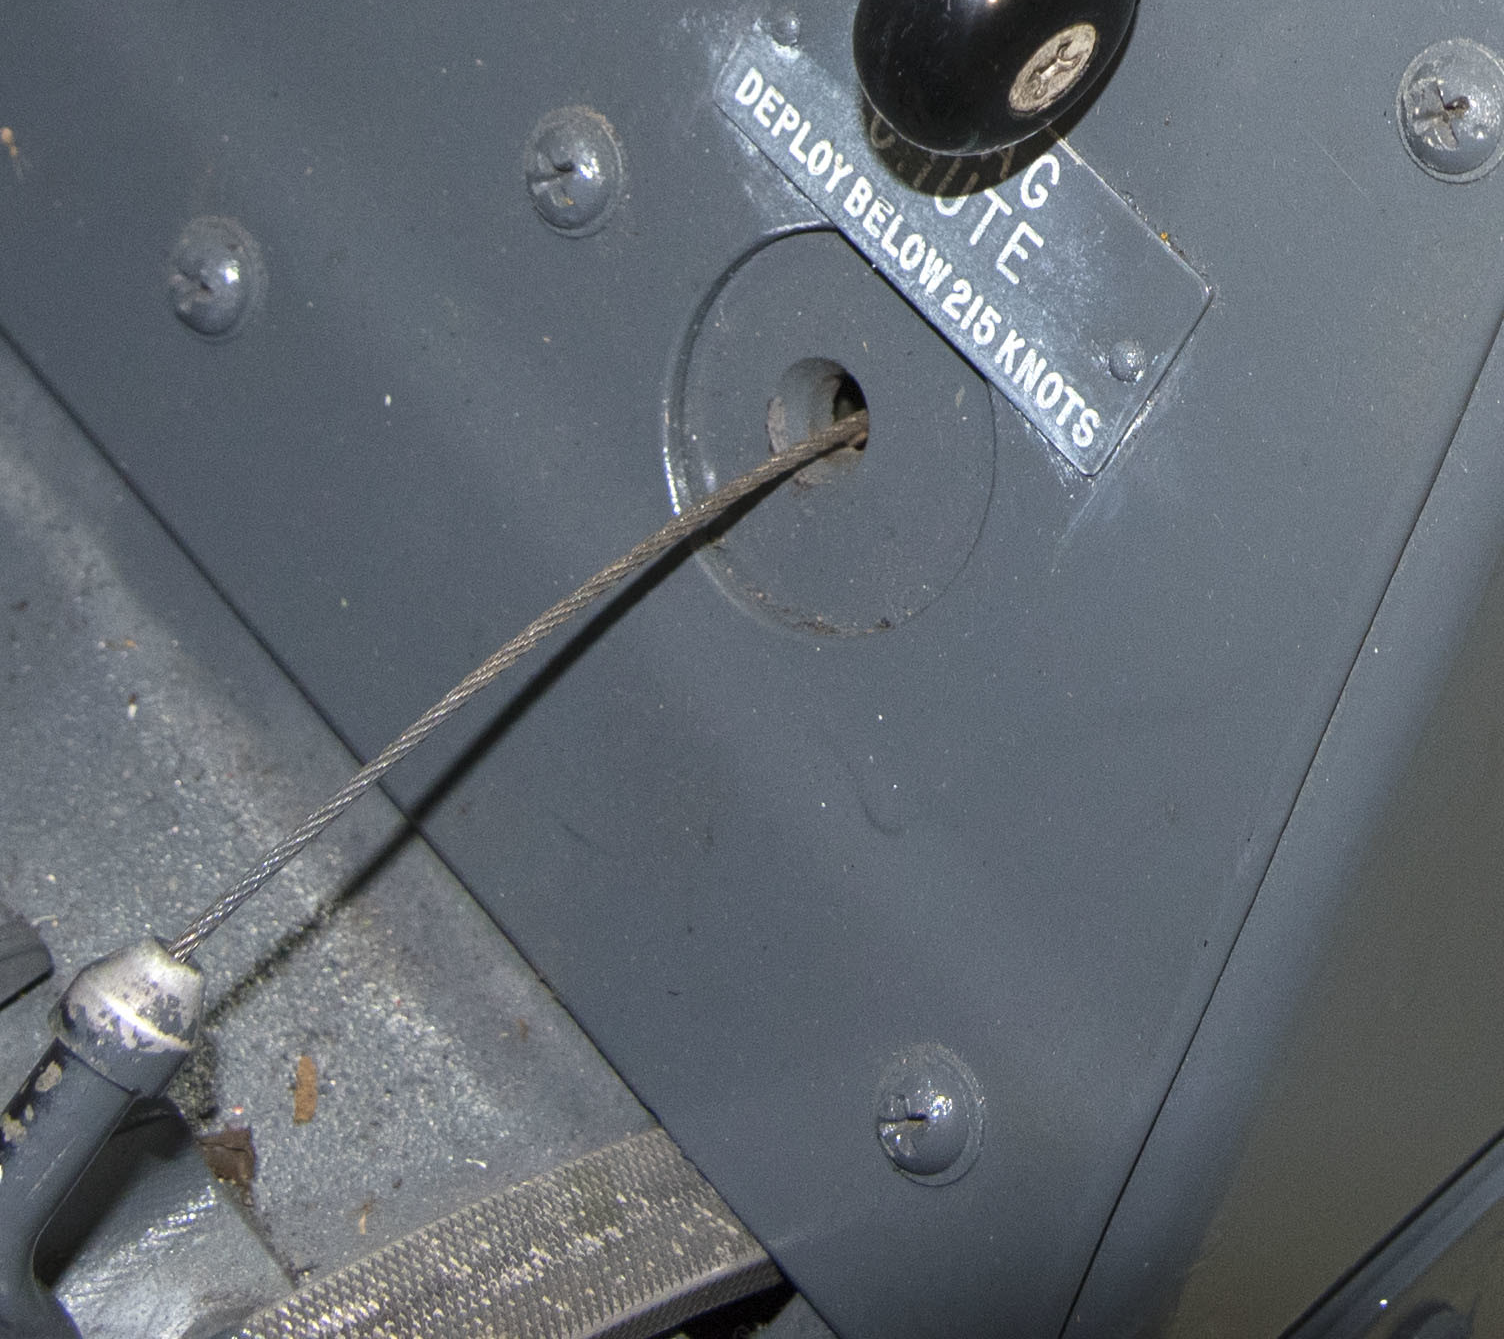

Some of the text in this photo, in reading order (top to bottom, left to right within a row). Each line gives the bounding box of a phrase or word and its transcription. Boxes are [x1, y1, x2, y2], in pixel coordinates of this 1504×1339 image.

[734, 67, 1102, 449] DEPLOY BELOW 215 KNOTS
